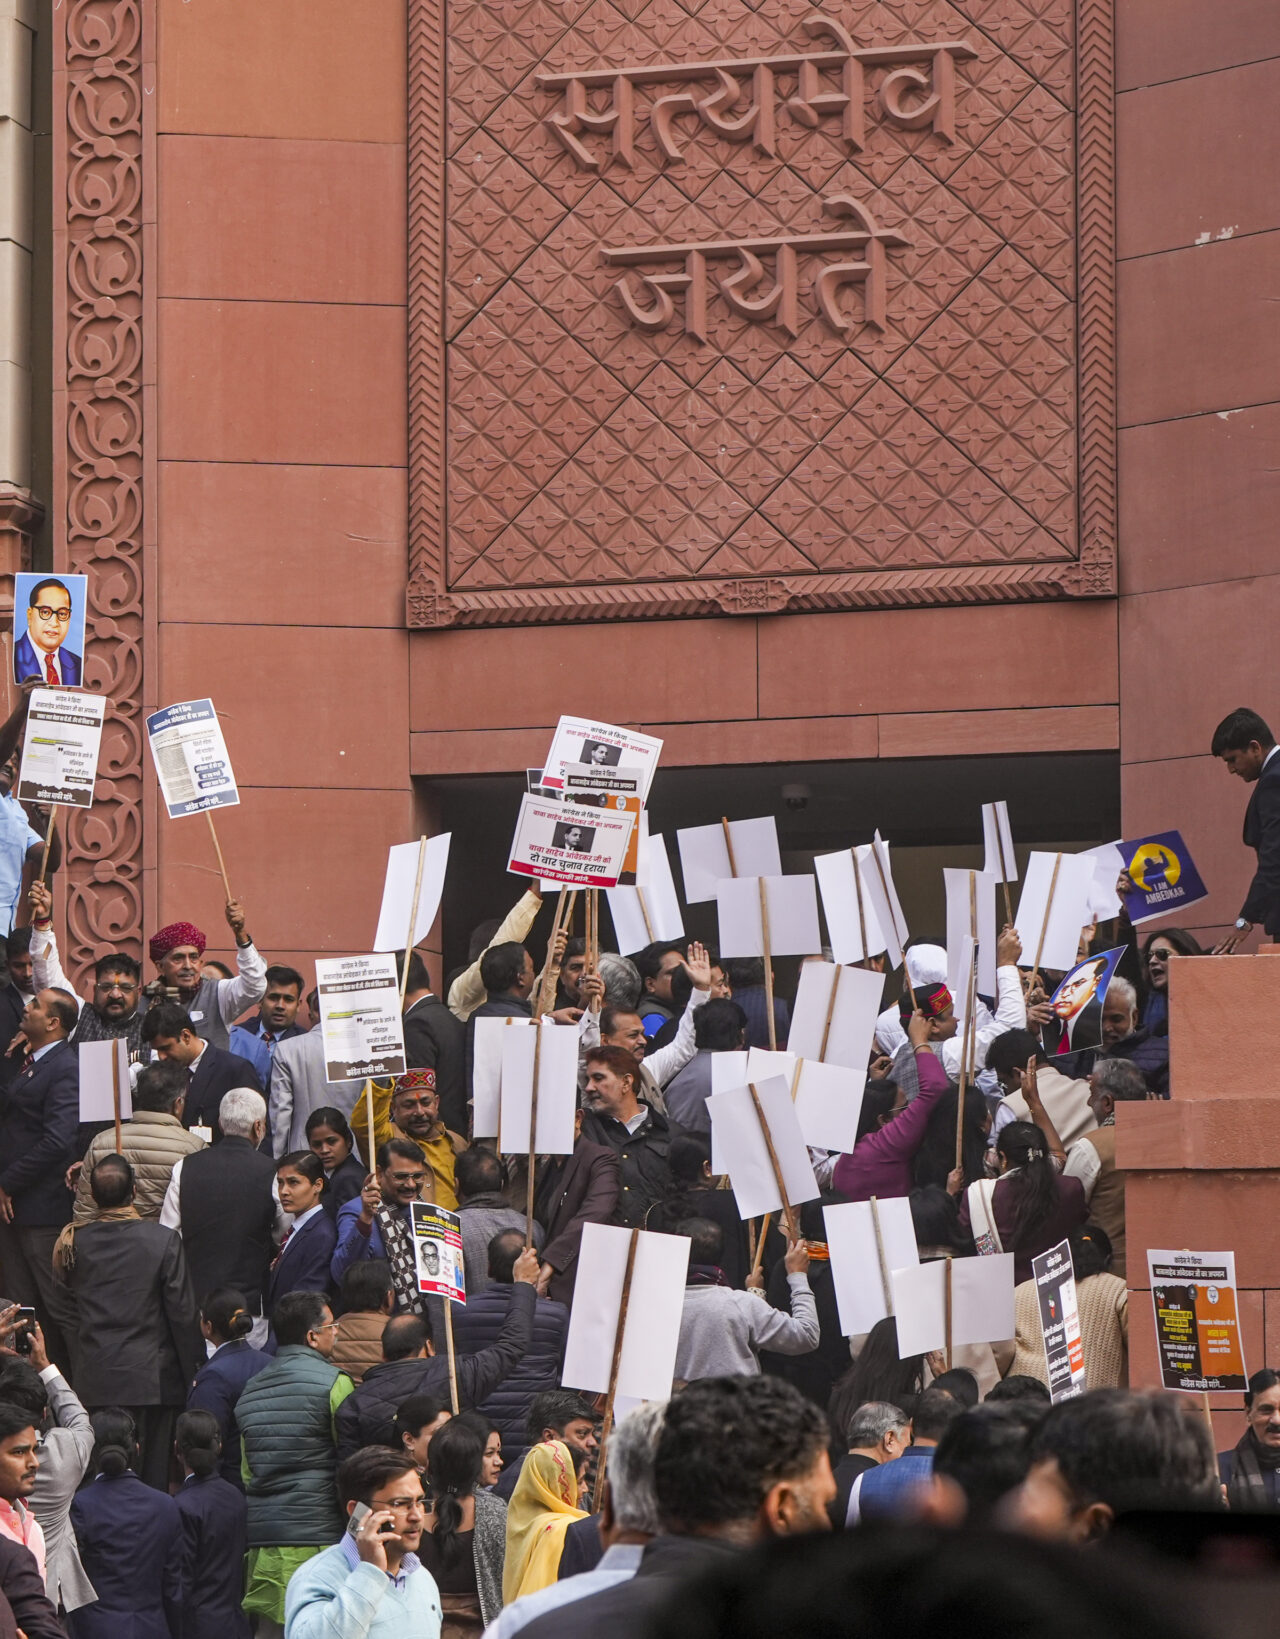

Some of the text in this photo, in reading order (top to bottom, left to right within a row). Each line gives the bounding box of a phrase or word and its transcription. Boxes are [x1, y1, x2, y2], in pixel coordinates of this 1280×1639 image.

[535, 15, 978, 170] सत्यमेव
[600, 196, 914, 345] जयते
[529, 851, 540, 861] दो
[557, 859, 582, 873] चुनाव
[583, 863, 606, 874] हराया
[592, 854, 602, 862] जी
[602, 855, 611, 863] को
[1145, 887, 1185, 904] AMBEDKAR
